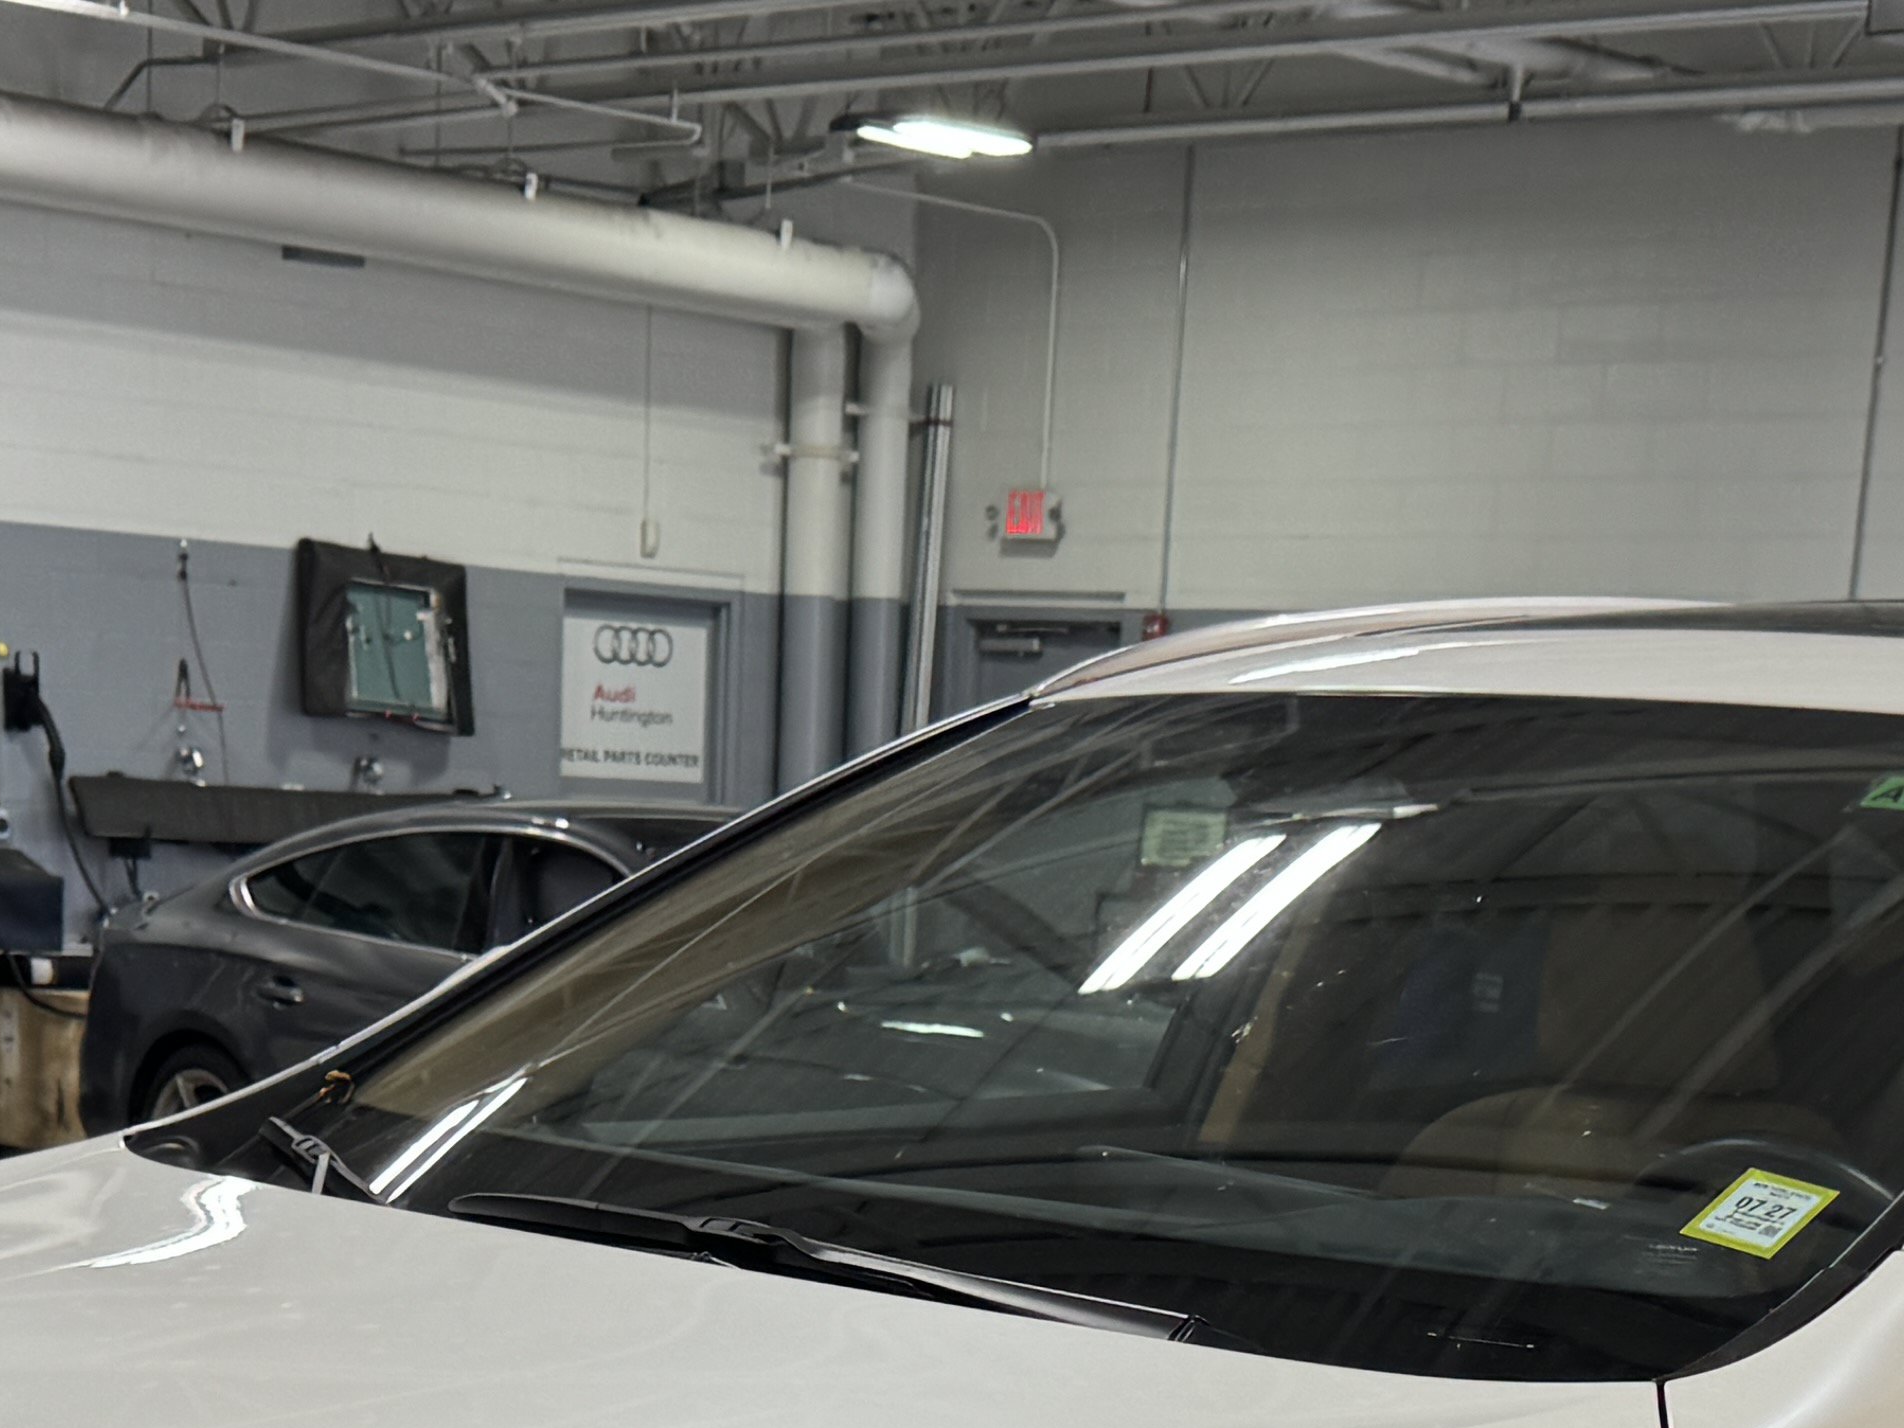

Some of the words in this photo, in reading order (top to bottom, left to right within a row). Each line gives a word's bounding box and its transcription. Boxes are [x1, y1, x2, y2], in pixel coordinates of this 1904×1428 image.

[1006, 488, 1045, 535] EXIT
[594, 683, 636, 703] Audi
[590, 705, 673, 728] Huntington
[603, 749, 640, 765] PARTS
[645, 752, 699, 767] COUNTER
[1735, 1196, 1767, 1212] 07
[1767, 1204, 1798, 1219] 27
